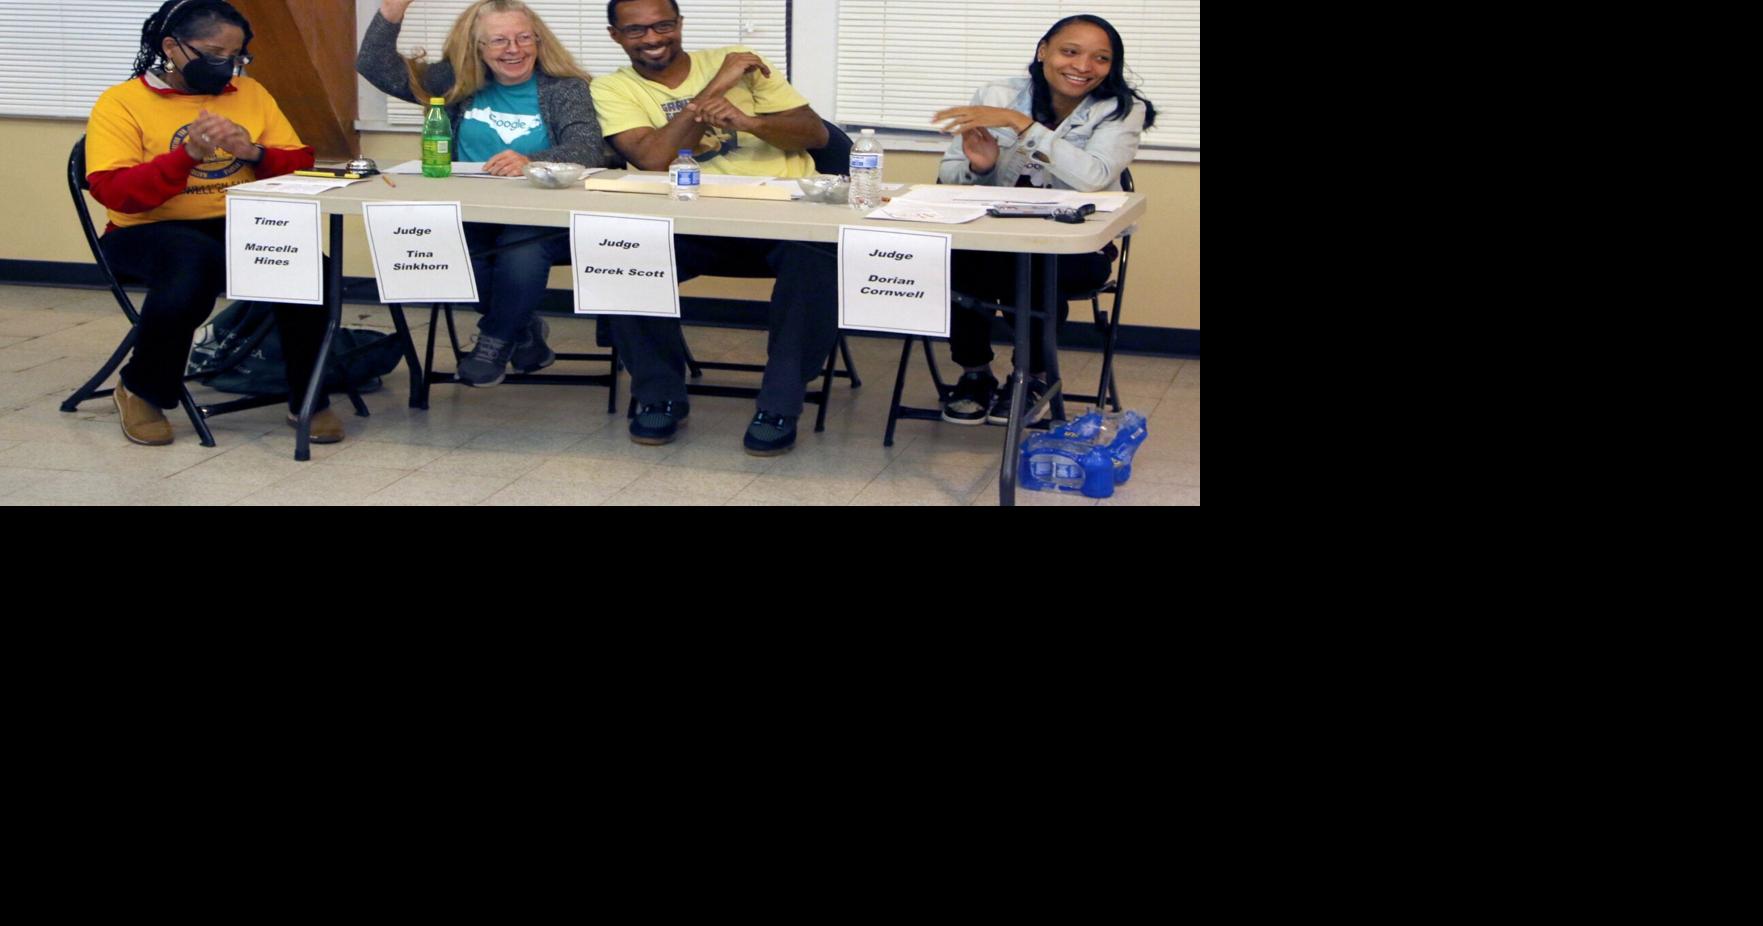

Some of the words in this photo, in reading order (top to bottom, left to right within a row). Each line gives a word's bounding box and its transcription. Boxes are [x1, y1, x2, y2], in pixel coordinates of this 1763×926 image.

[254, 216, 290, 227] Timer
[393, 226, 432, 237] Judge
[244, 242, 299, 253] Marcella
[598, 238, 641, 250] Judge
[406, 250, 434, 258] Tina
[868, 248, 914, 261] Judge
[253, 256, 290, 266] Hines
[392, 262, 449, 271] Sinkhorn
[584, 265, 624, 275] Derek
[628, 268, 665, 278] Scott
[867, 274, 916, 286] Dorian
[859, 286, 925, 299] Cornwell
